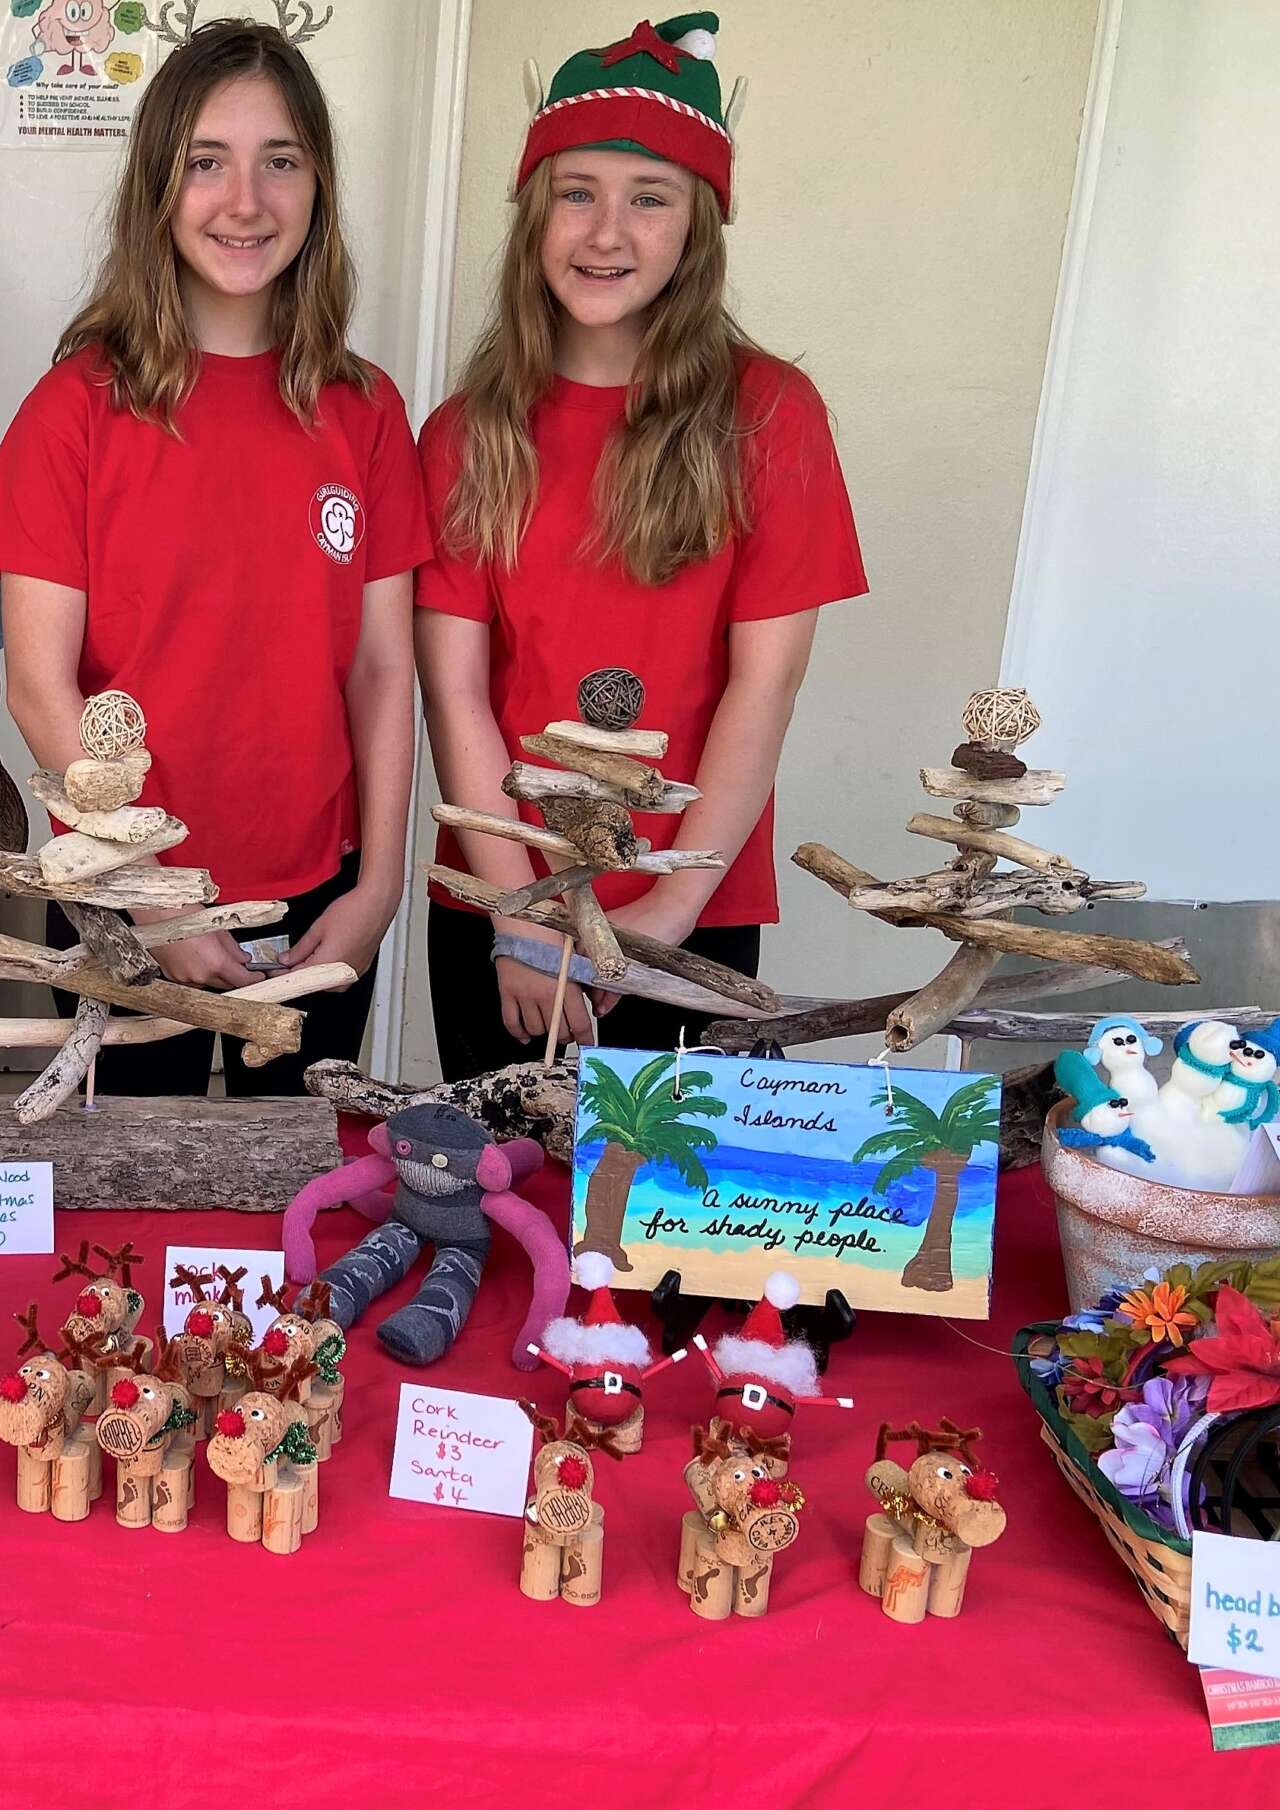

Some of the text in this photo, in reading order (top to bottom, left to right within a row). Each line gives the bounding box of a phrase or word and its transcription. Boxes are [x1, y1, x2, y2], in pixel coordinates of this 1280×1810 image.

[18, 126, 37, 136] YOUR
[38, 126, 65, 136] MENTAL
[66, 127, 92, 137] HEALTH
[739, 1067, 847, 1096] Cayman
[733, 1104, 838, 1132] Islands
[728, 1190, 820, 1228] sunny
[828, 1197, 909, 1226] place
[639, 1209, 887, 1258] for shady people.
[182, 1262, 224, 1281] ock
[411, 1398, 459, 1421] Cork
[413, 1419, 504, 1449] Reindeer
[435, 1441, 462, 1461] $3
[410, 1459, 473, 1487] Santa
[433, 1481, 470, 1506] $4
[1205, 1581, 1261, 1617] head
[1226, 1621, 1264, 1655] $2
